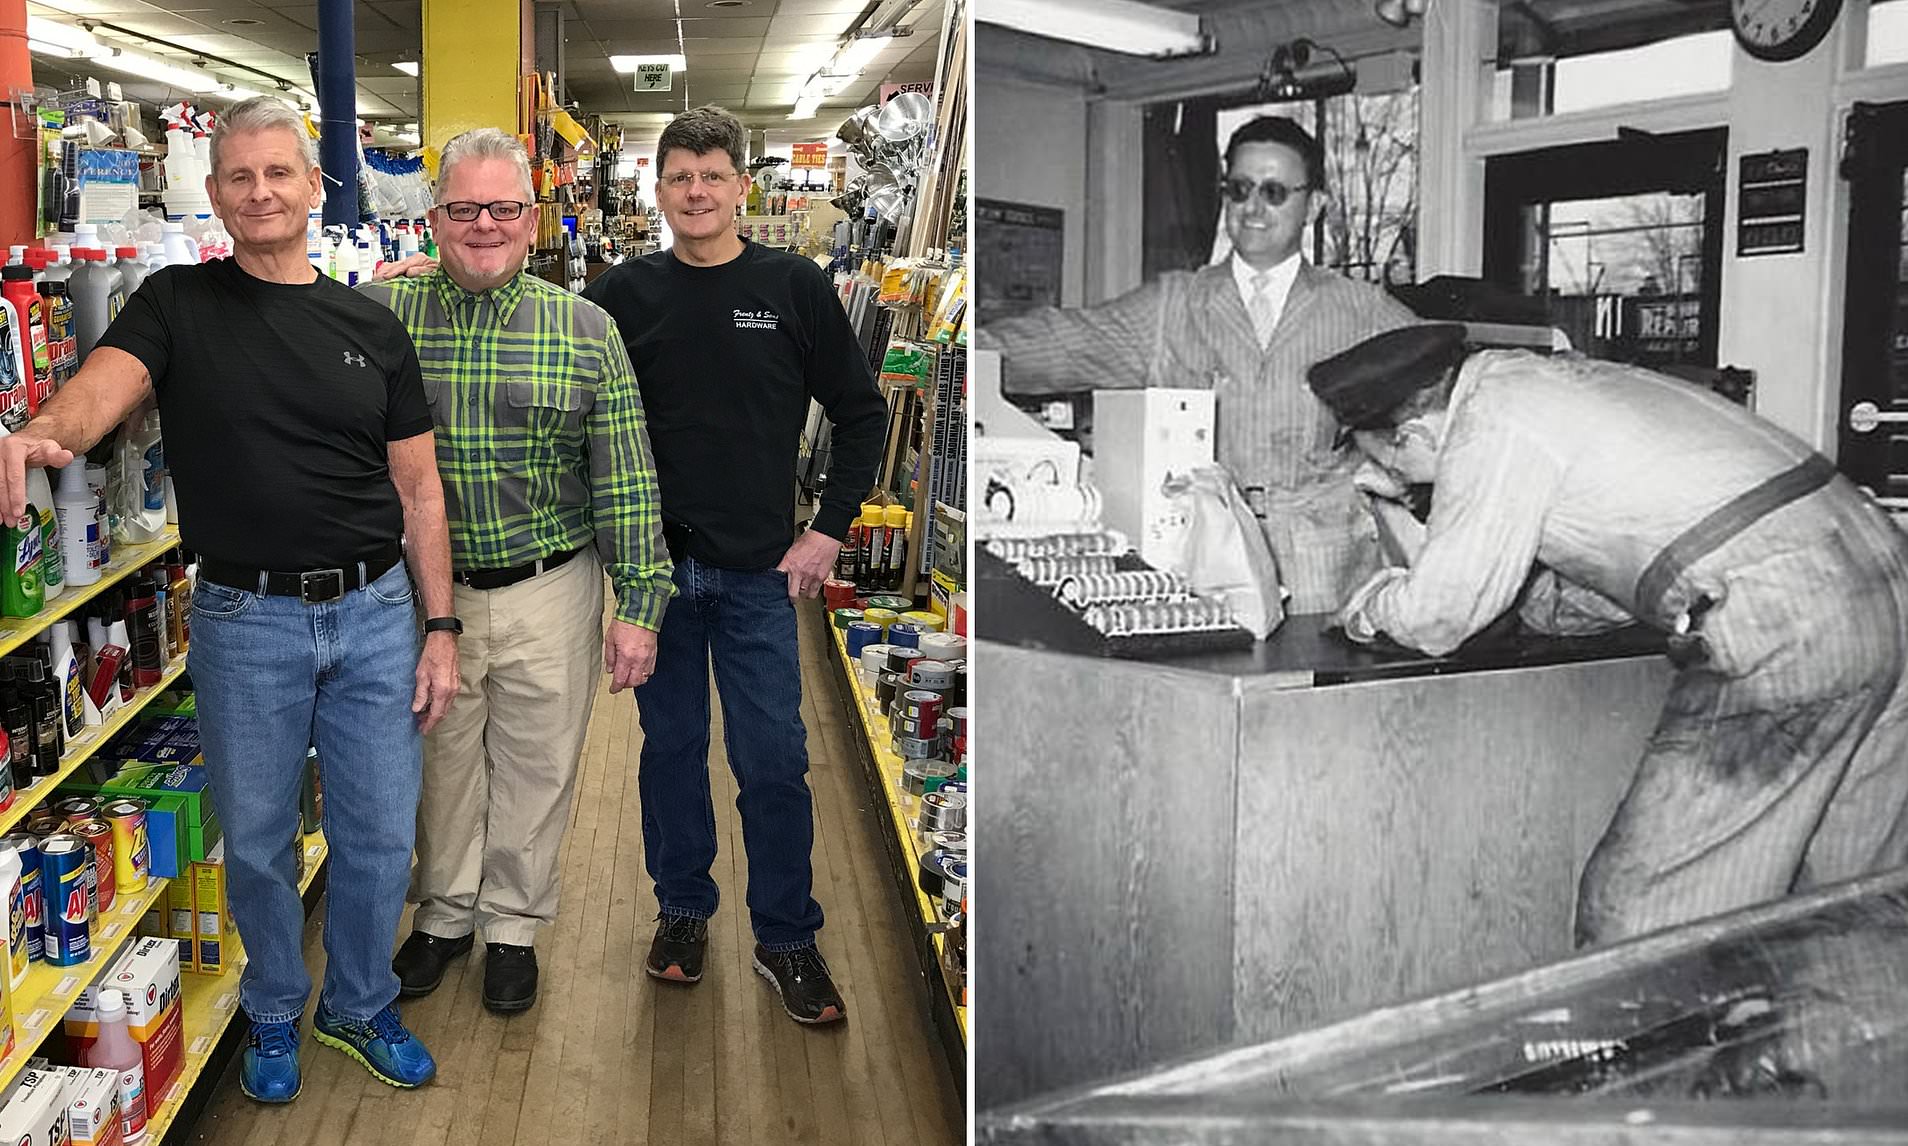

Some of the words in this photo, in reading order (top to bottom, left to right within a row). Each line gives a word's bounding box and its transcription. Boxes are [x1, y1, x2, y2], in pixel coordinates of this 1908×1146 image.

[638, 64, 654, 72] KEYS
[644, 73, 662, 82] HERE
[735, 321, 777, 330] HARDWARE
[941, 358, 951, 381] DRAFT
[938, 383, 949, 403] STOP
[936, 404, 947, 419] FOR
[933, 420, 945, 457] WINDOWS
[947, 422, 960, 460] WINDOWS
[136, 939, 157, 956] Dirtex
[20, 1071, 39, 1087] TSP
[48, 1107, 66, 1146] TSP
